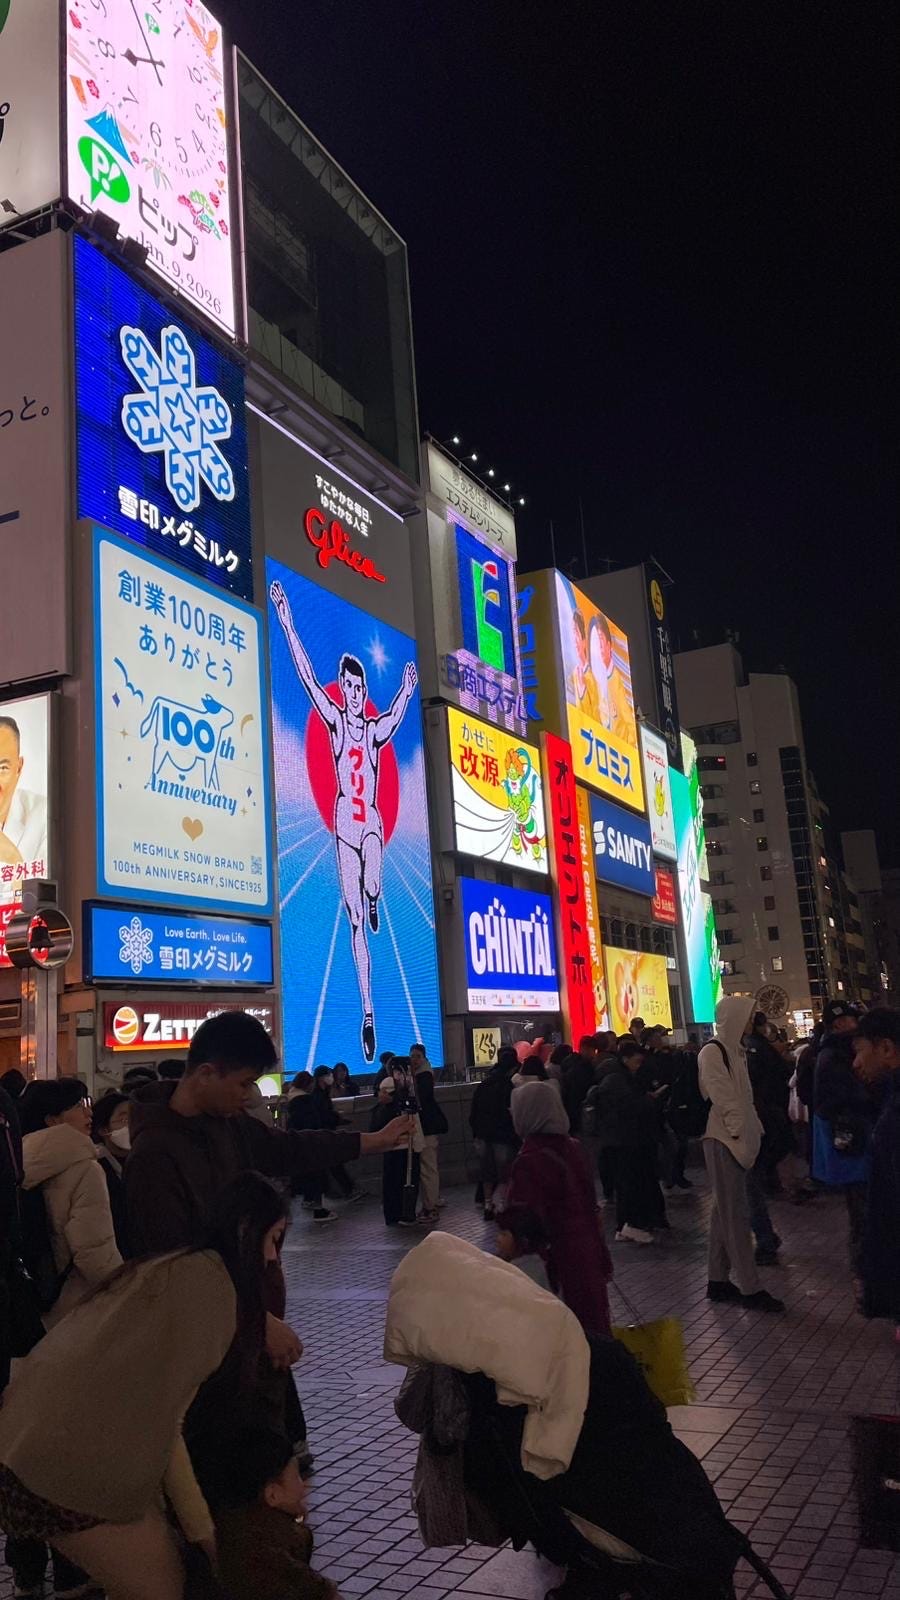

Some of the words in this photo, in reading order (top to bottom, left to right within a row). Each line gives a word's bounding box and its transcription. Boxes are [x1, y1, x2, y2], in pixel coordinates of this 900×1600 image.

[97, 38, 116, 59] 8
[122, 86, 139, 104] 7
[150, 122, 162, 147] 6
[175, 137, 188, 163] 5
[192, 130, 206, 153] 4
[138, 184, 199, 262] ピップ
[118, 485, 239, 572] 雪印メグミルク
[320, 493, 369, 536] ゆたかな人生
[446, 487, 505, 545] エステムシリーズ
[304, 507, 386, 583] Glico
[118, 570, 247, 653] 創業100周年
[139, 624, 233, 687] ありがとう
[461, 723, 495, 752] かぜに
[459, 744, 500, 787] 改源
[580, 728, 634, 792] プロミス
[144, 772, 237, 816] Anniversary
[348, 745, 366, 823] グリコ
[113, 859, 141, 875] 100th
[133, 841, 180, 861] MEGMILK
[183, 850, 211, 866] SNOW
[214, 856, 245, 872] BRAND
[607, 826, 651, 872] SAMTY
[1, 860, 45, 882] 容外科
[165, 926, 183, 938] Love
[185, 928, 210, 940] Earth.
[213, 930, 230, 942] Love
[231, 932, 247, 944] Life.
[159, 945, 253, 972] 雪印メグミルク
